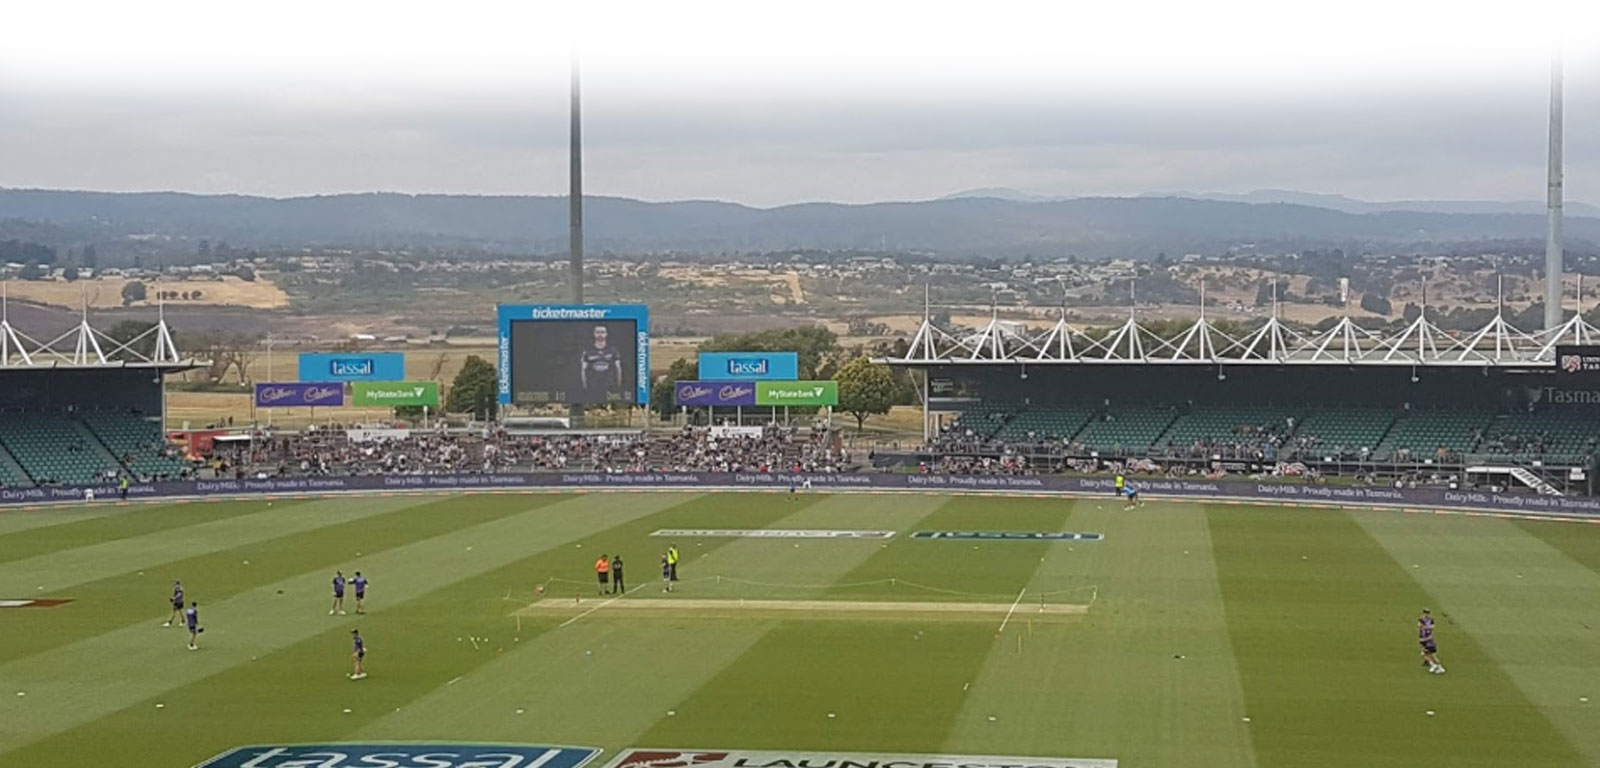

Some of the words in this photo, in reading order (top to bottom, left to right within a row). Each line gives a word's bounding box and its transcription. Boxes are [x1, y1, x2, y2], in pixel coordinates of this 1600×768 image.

[532, 307, 606, 319] ticketmaster
[333, 360, 371, 375] tassal
[500, 336, 511, 394] ticketmaster
[637, 331, 648, 393] ticketmaster
[730, 359, 766, 374] tassal
